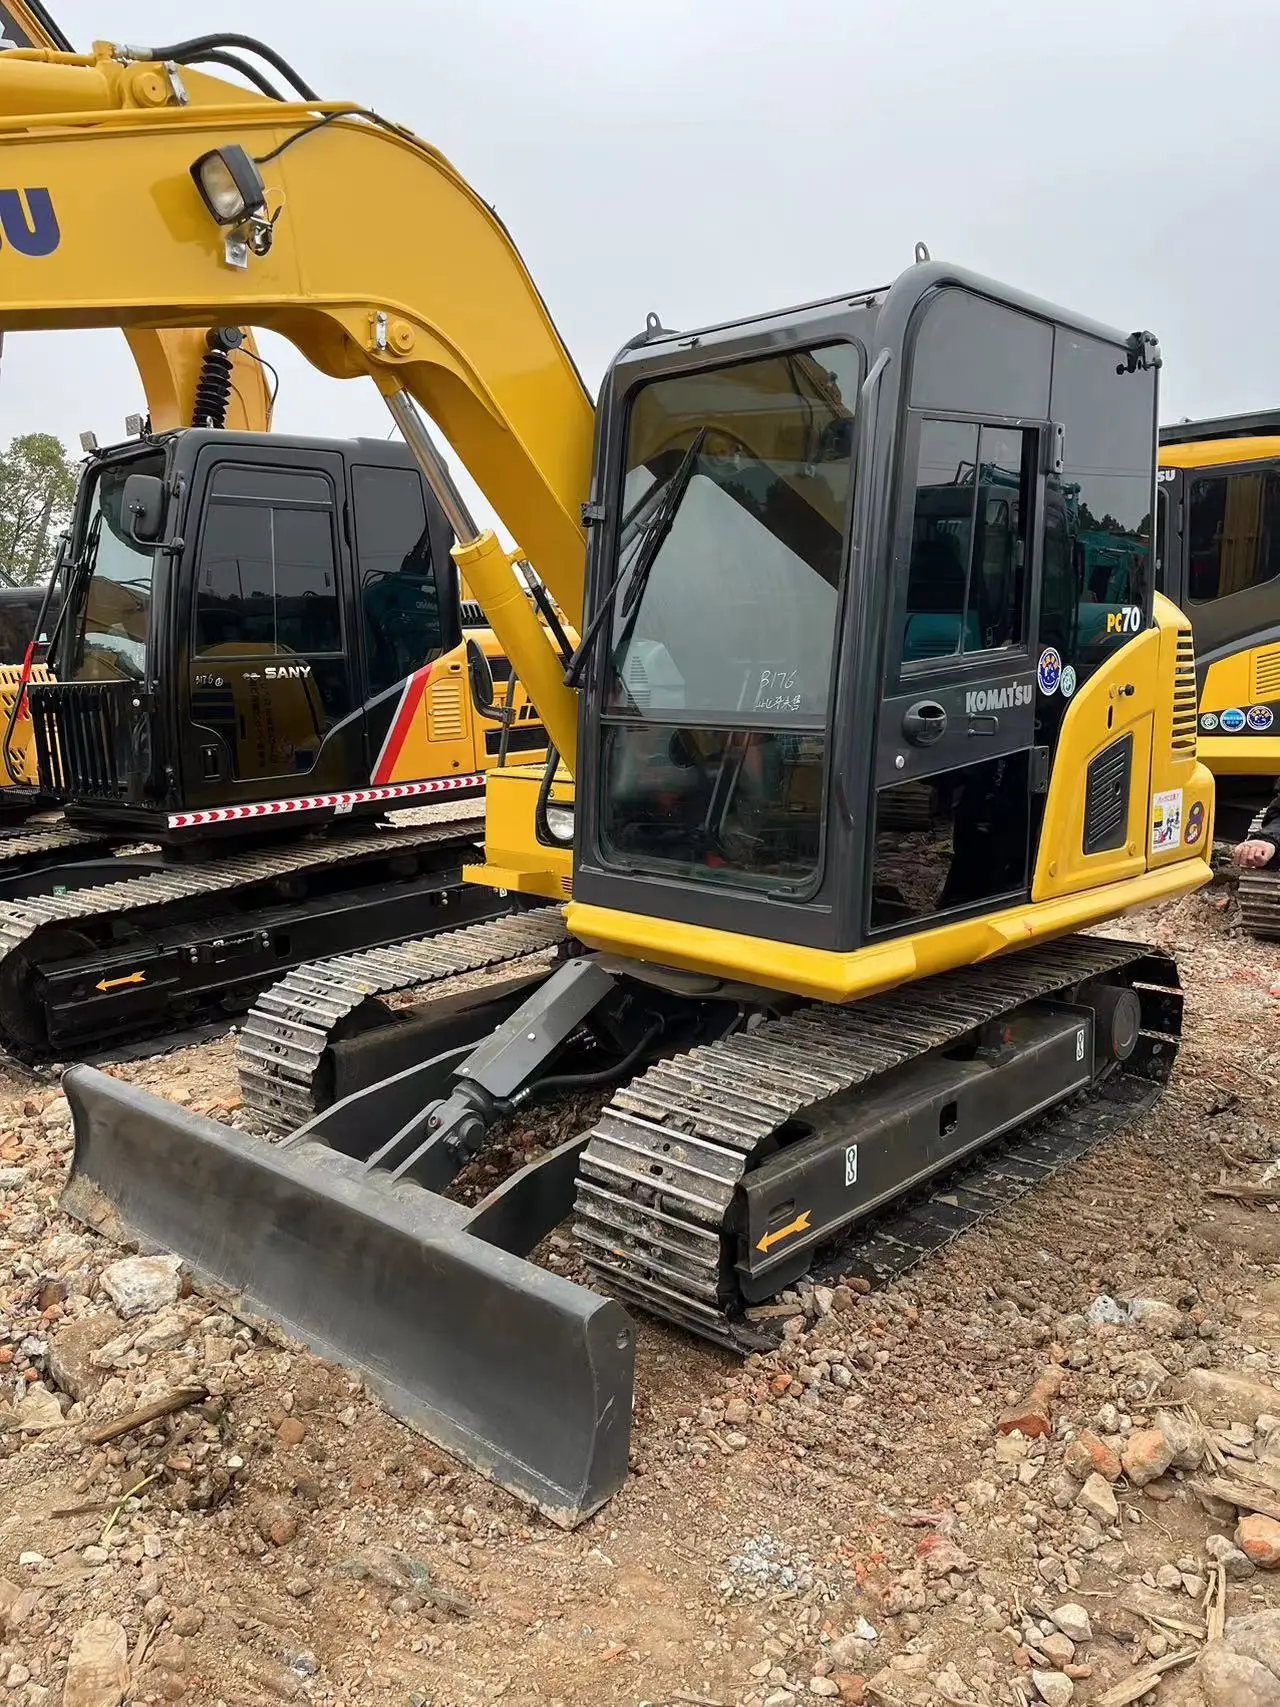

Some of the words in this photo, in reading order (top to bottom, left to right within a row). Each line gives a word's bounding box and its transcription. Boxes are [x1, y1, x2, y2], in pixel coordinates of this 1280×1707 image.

[0, 188, 60, 256] U
[1107, 606, 1140, 633] PC70
[264, 666, 311, 679] SANY
[760, 669, 797, 689] B176
[966, 681, 1033, 713] KOMATSU
